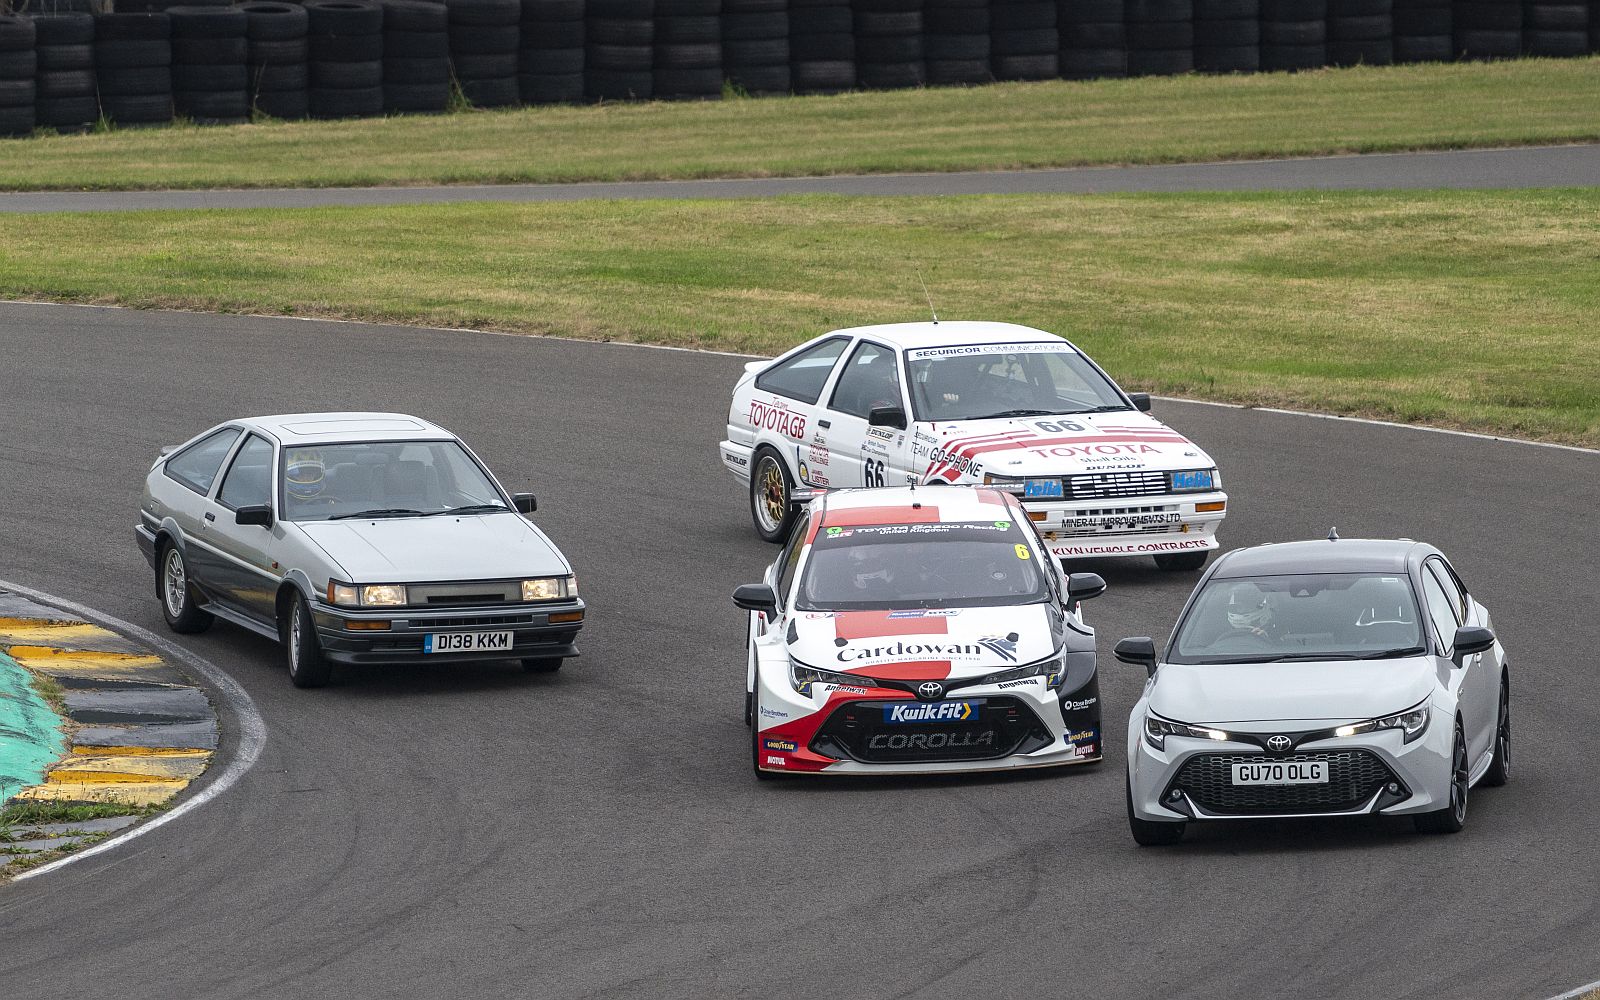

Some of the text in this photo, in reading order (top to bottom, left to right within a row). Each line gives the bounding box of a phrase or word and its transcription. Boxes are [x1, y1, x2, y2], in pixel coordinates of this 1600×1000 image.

[916, 345, 1066, 358] SECURICOR COMMUNICATIONS
[1034, 420, 1086, 433] 66
[870, 428, 894, 440] DUNLOP
[914, 431, 938, 444] SECURICOR
[809, 444, 829, 458] TOYOTA
[1028, 443, 1163, 459] TOYOTA
[726, 453, 748, 467] DUNLOP
[910, 441, 929, 457] TEAM
[929, 447, 983, 478] GO-PHONE
[864, 457, 885, 487] 66
[1085, 463, 1146, 471] DUNLOP
[1173, 471, 1212, 489] Hella
[963, 524, 1008, 532] Racing
[1061, 518, 1097, 528] MINERAL
[1099, 514, 1165, 527] IMPROVEMENTS
[1014, 543, 1031, 561] 6
[1052, 547, 1083, 556] KLYN
[1137, 539, 1209, 551] CONTRACTS
[438, 633, 508, 650] D138 KKM
[836, 641, 981, 663] Cardowan
[824, 684, 868, 695] Angelwax
[997, 678, 1039, 689] Angelwax
[868, 730, 994, 749] COROLLA
[1068, 730, 1094, 742] GOODYEAR
[767, 741, 795, 751] GOODYEAR
[1075, 744, 1094, 755] MOTUL
[767, 755, 786, 766] MOTUL
[1239, 764, 1321, 781] GU70 OLG
